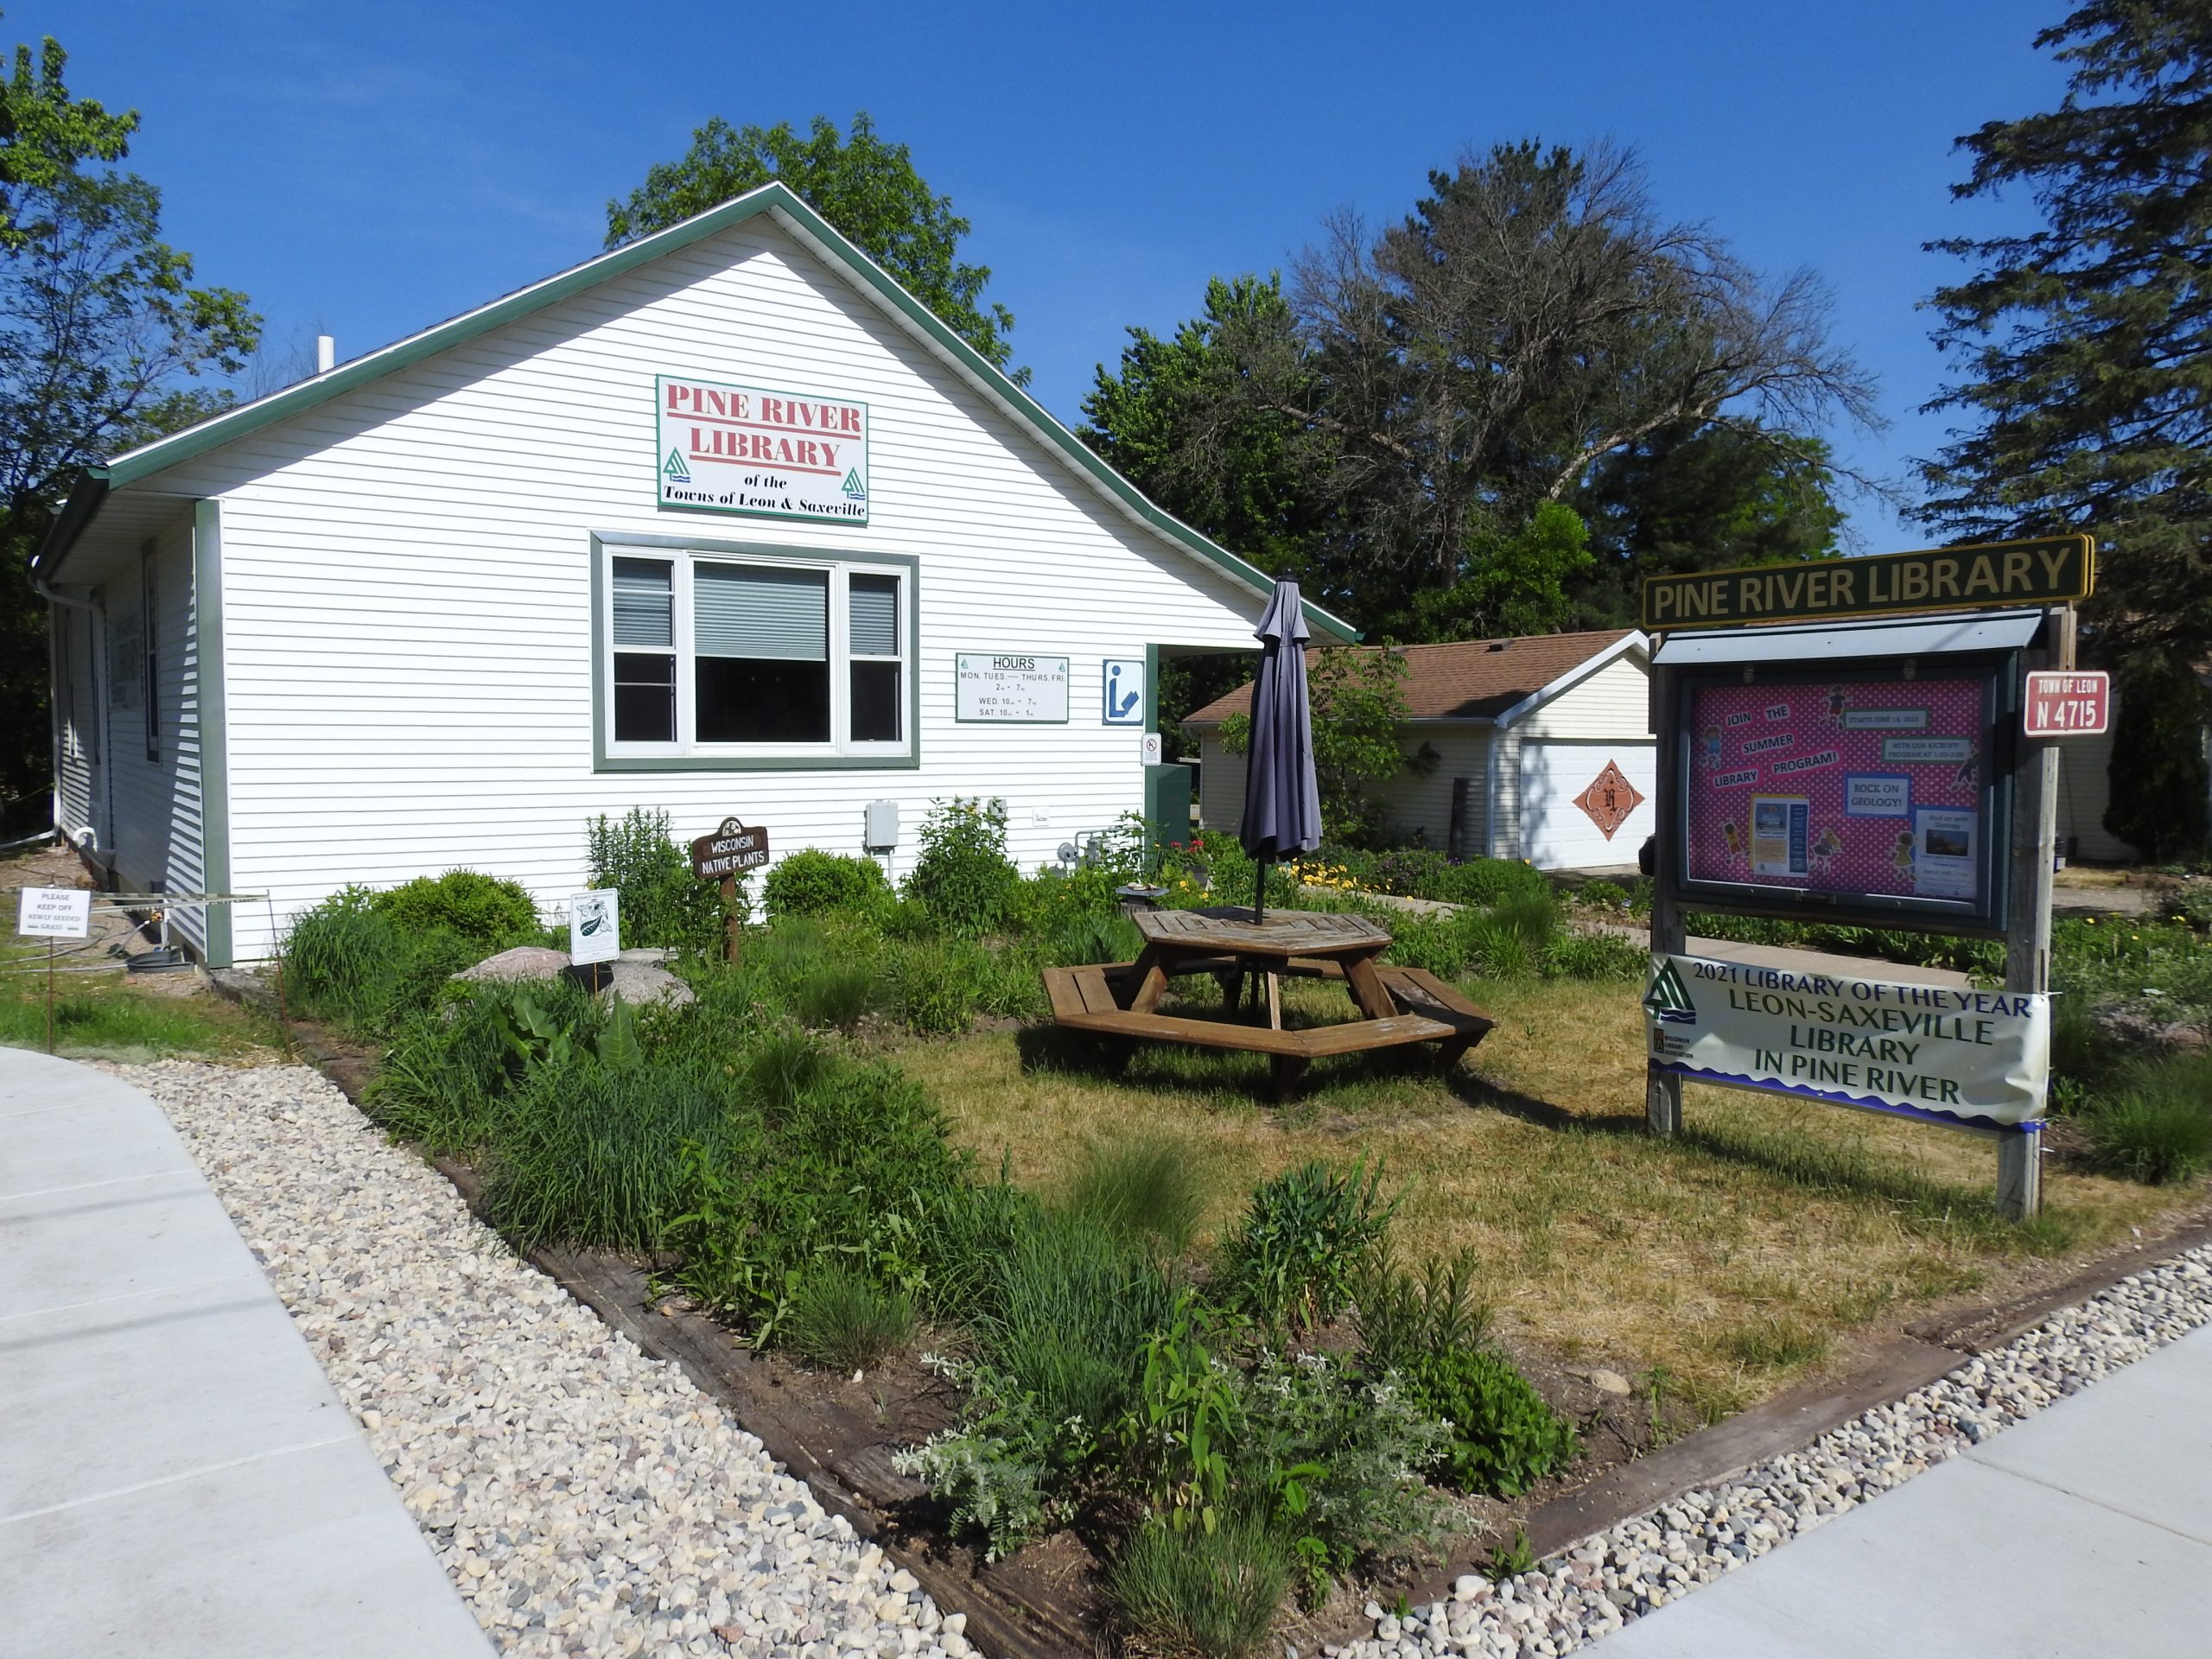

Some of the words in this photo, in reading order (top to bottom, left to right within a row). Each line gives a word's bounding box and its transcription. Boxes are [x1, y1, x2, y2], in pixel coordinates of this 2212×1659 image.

[666, 384, 749, 419] PINE
[760, 397, 861, 432] RIVER
[690, 428, 840, 467] LIBRARY
[745, 474, 760, 487] of
[765, 476, 786, 489] the
[664, 486, 715, 503] Towns
[720, 492, 735, 505] of
[740, 493, 775, 508] Leon
[781, 498, 792, 509] &
[799, 499, 865, 517] Saxeville
[1655, 581, 1728, 619] PINE
[1740, 569, 1854, 613] RIVER
[1868, 548, 2071, 604] LIBRARY
[994, 658, 1035, 669] HOURS
[2039, 680, 2060, 693] TOWN
[2063, 680, 2073, 693] OF
[2076, 680, 2097, 693] LEON
[1727, 712, 1751, 726] JOIN
[1766, 706, 1788, 720] THE
[2037, 701, 2049, 728] N
[2054, 701, 2096, 728] 4715
[1744, 734, 1794, 753] SUMMER
[1714, 771, 1757, 787] LIBRARY
[1773, 751, 1837, 774] PROGRAM!
[1854, 784, 1880, 792] ROCK
[711, 835, 753, 854] WISCONSIN
[702, 856, 731, 874] NATIVE
[733, 851, 765, 868] PLANTS
[1694, 962, 1738, 983] 2021
[1745, 968, 1846, 998] LIBRARY
[1851, 981, 1888, 1002] OF
[1897, 986, 1950, 1009] THE
[1953, 991, 2032, 1018] YEAR
[1729, 988, 1994, 1046] LEON-SAXEVILLE
[1790, 1025, 1920, 1065] LIBRARY
[1754, 1048, 1783, 1075] IN
[1791, 1055, 1860, 1088] PINE
[1866, 1066, 1961, 1105] RIVER
